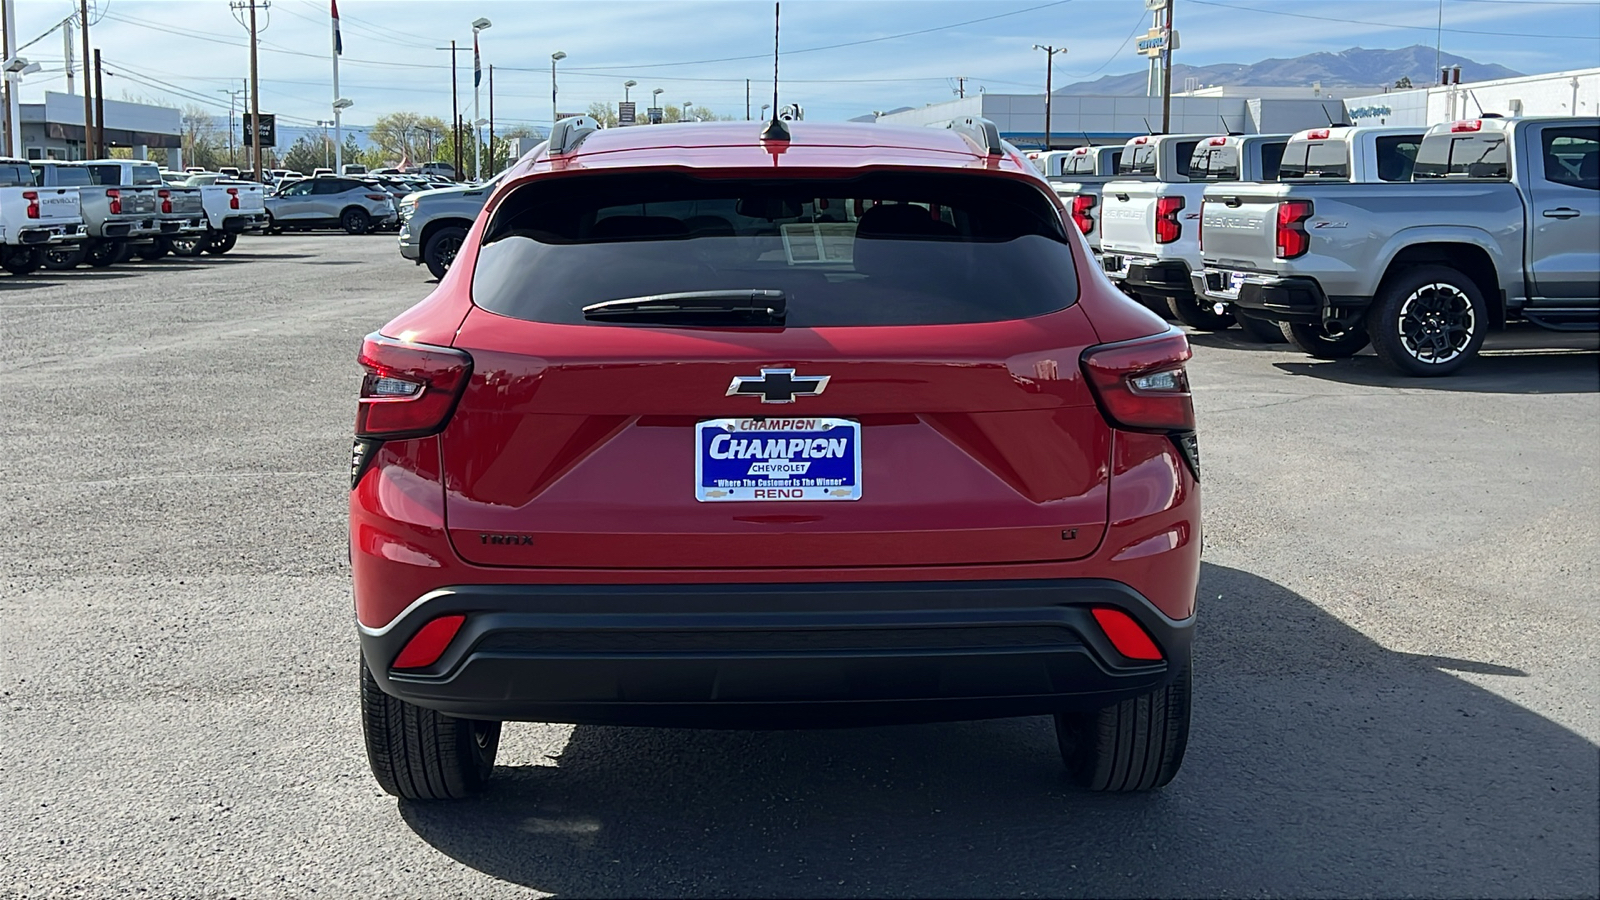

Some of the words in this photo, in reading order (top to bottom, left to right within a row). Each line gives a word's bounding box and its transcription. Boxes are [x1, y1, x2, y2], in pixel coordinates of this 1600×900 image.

[1203, 216, 1263, 230] CHEVROLET
[740, 419, 816, 431] CHAMPION
[709, 434, 848, 460] CHAMPION
[752, 464, 806, 472] CHEVROLET
[743, 479, 756, 487] The
[757, 479, 792, 487] Customer
[793, 479, 801, 487] Is
[802, 479, 815, 487] The
[754, 489, 804, 498] RENO
[479, 533, 534, 546] TRAX
[1061, 529, 1078, 540] LT
